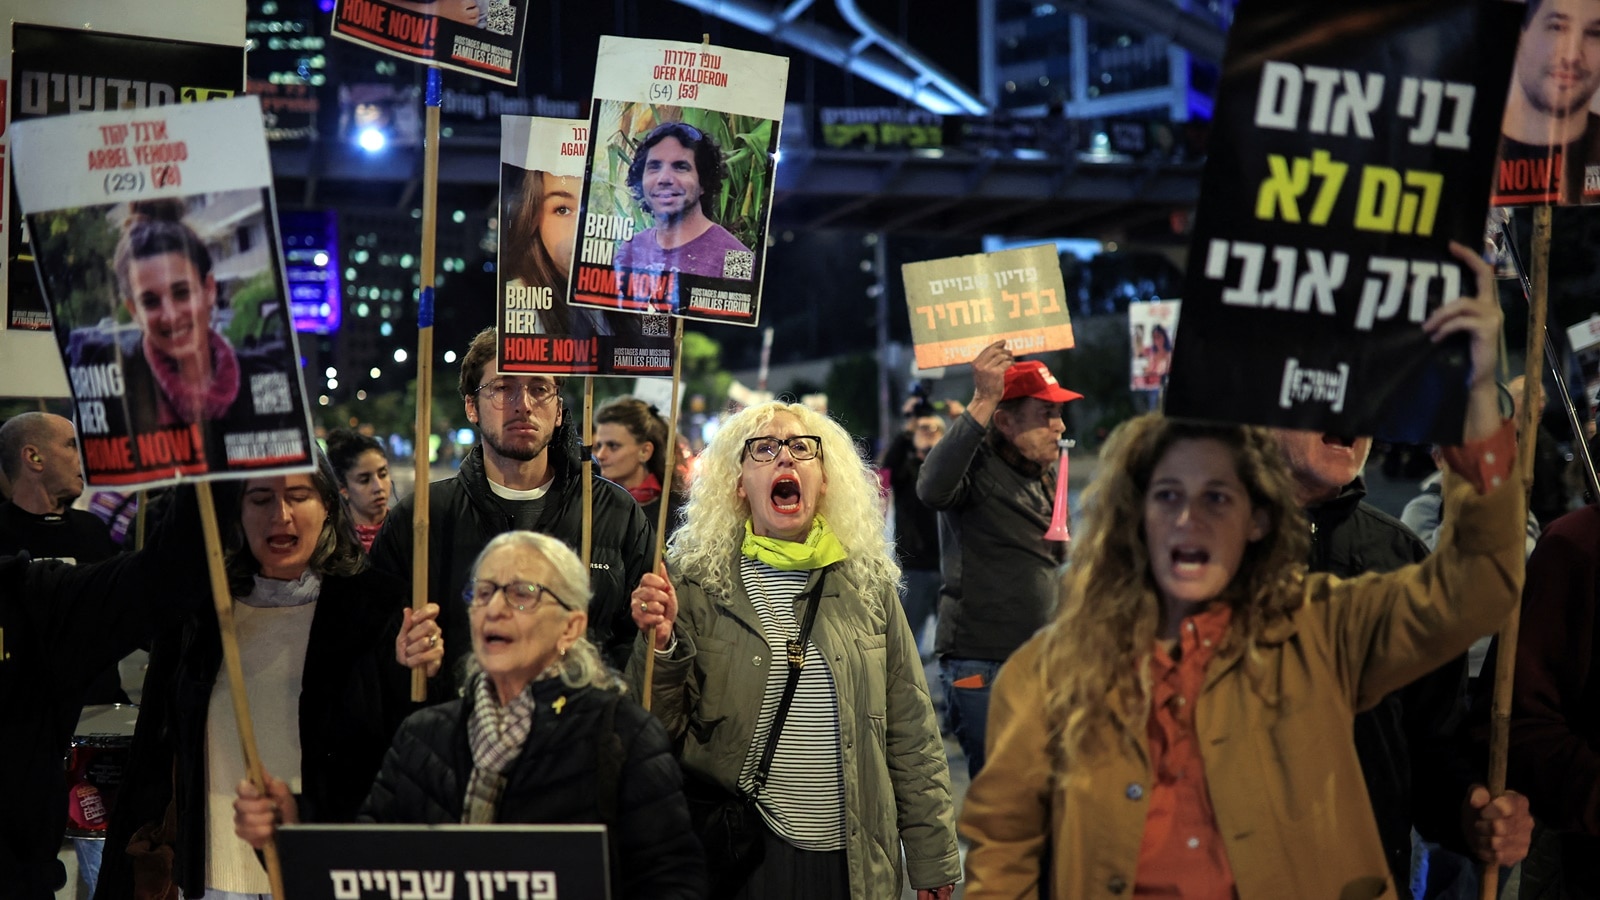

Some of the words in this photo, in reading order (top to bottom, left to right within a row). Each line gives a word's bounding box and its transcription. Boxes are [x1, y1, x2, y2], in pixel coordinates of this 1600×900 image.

[342, 0, 386, 33] HOME
[388, 11, 438, 47] NOW!
[453, 43, 486, 64] FAMILIES
[486, 51, 512, 70] FORUM
[454, 35, 480, 49] HOSTAGES
[480, 41, 491, 51] AND
[491, 43, 512, 58] MISSING
[664, 49, 697, 68] קלדרון
[699, 53, 722, 70] עופר
[653, 65, 677, 81] OFER
[679, 69, 728, 88] KALDERON
[649, 84, 673, 101] (54)
[678, 83, 699, 101] (53)
[1255, 60, 1386, 140] אדם
[1397, 75, 1476, 150] בני
[99, 123, 130, 146] יהוד
[572, 127, 588, 141] רגר
[88, 148, 131, 171] ARBEL
[133, 141, 188, 166] YEHOUD
[103, 172, 146, 195] (29)
[1500, 153, 1562, 191] NOW!
[1255, 149, 1349, 226] לא
[1353, 163, 1444, 237] הם
[585, 212, 635, 241] BRING
[580, 237, 616, 266] HIM
[577, 266, 625, 295] HOME
[627, 270, 675, 302] NOW!
[928, 275, 989, 296] שבויים
[994, 267, 1038, 289] פדיון
[1205, 237, 1349, 315] אגבי
[505, 285, 553, 310] BRING
[690, 296, 723, 311] FAMILIES
[723, 299, 751, 314] FORUM
[691, 287, 718, 297] HOSTAGES
[718, 290, 728, 298] AND
[728, 291, 751, 302] MISSING
[1001, 288, 1061, 319] בכל
[505, 311, 536, 335] HER
[915, 297, 995, 330] מחיר
[504, 337, 549, 362] HOME
[553, 336, 598, 363] NOW!
[613, 355, 645, 367] FAMILIES
[645, 357, 670, 368] FORUM
[614, 347, 638, 356] HOSTAGES
[638, 348, 649, 356] AND
[649, 349, 671, 357] MISSING
[70, 363, 125, 399] BRING
[78, 400, 110, 434] HER
[84, 436, 137, 471] HOME
[137, 424, 205, 468] NOW!
[330, 870, 455, 900] שבויים
[464, 870, 557, 900] פדיון
